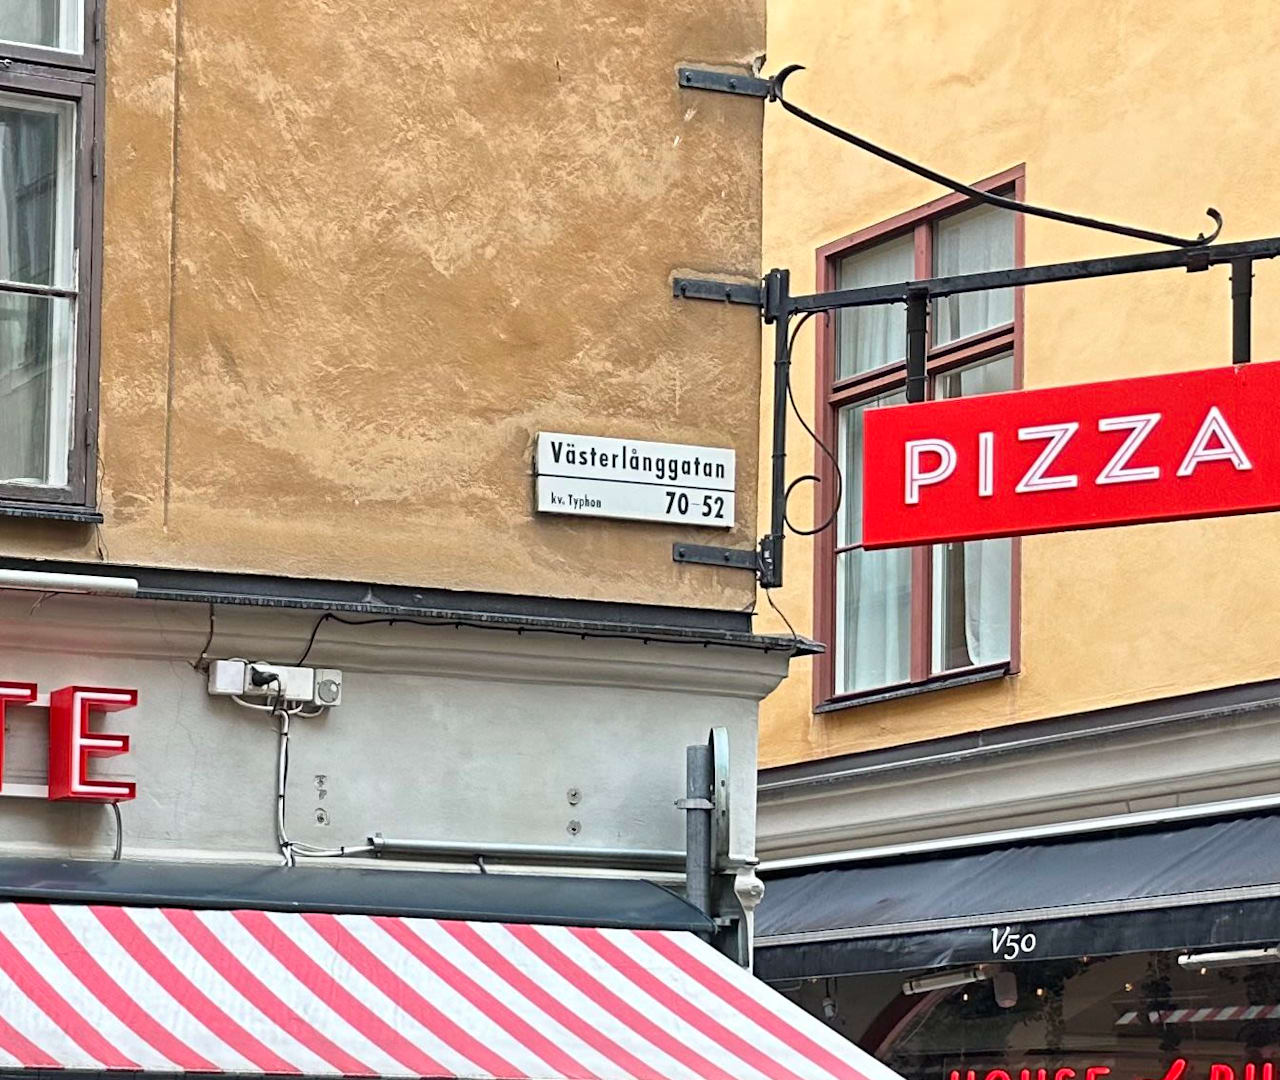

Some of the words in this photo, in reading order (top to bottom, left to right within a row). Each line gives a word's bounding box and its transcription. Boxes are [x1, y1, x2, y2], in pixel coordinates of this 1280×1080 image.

[550, 441, 726, 481] Västerlånggatan
[904, 405, 1252, 505] PIZZA
[550, 491, 566, 506] kv.
[568, 493, 602, 510] Typhon
[990, 926, 1037, 960] V50
